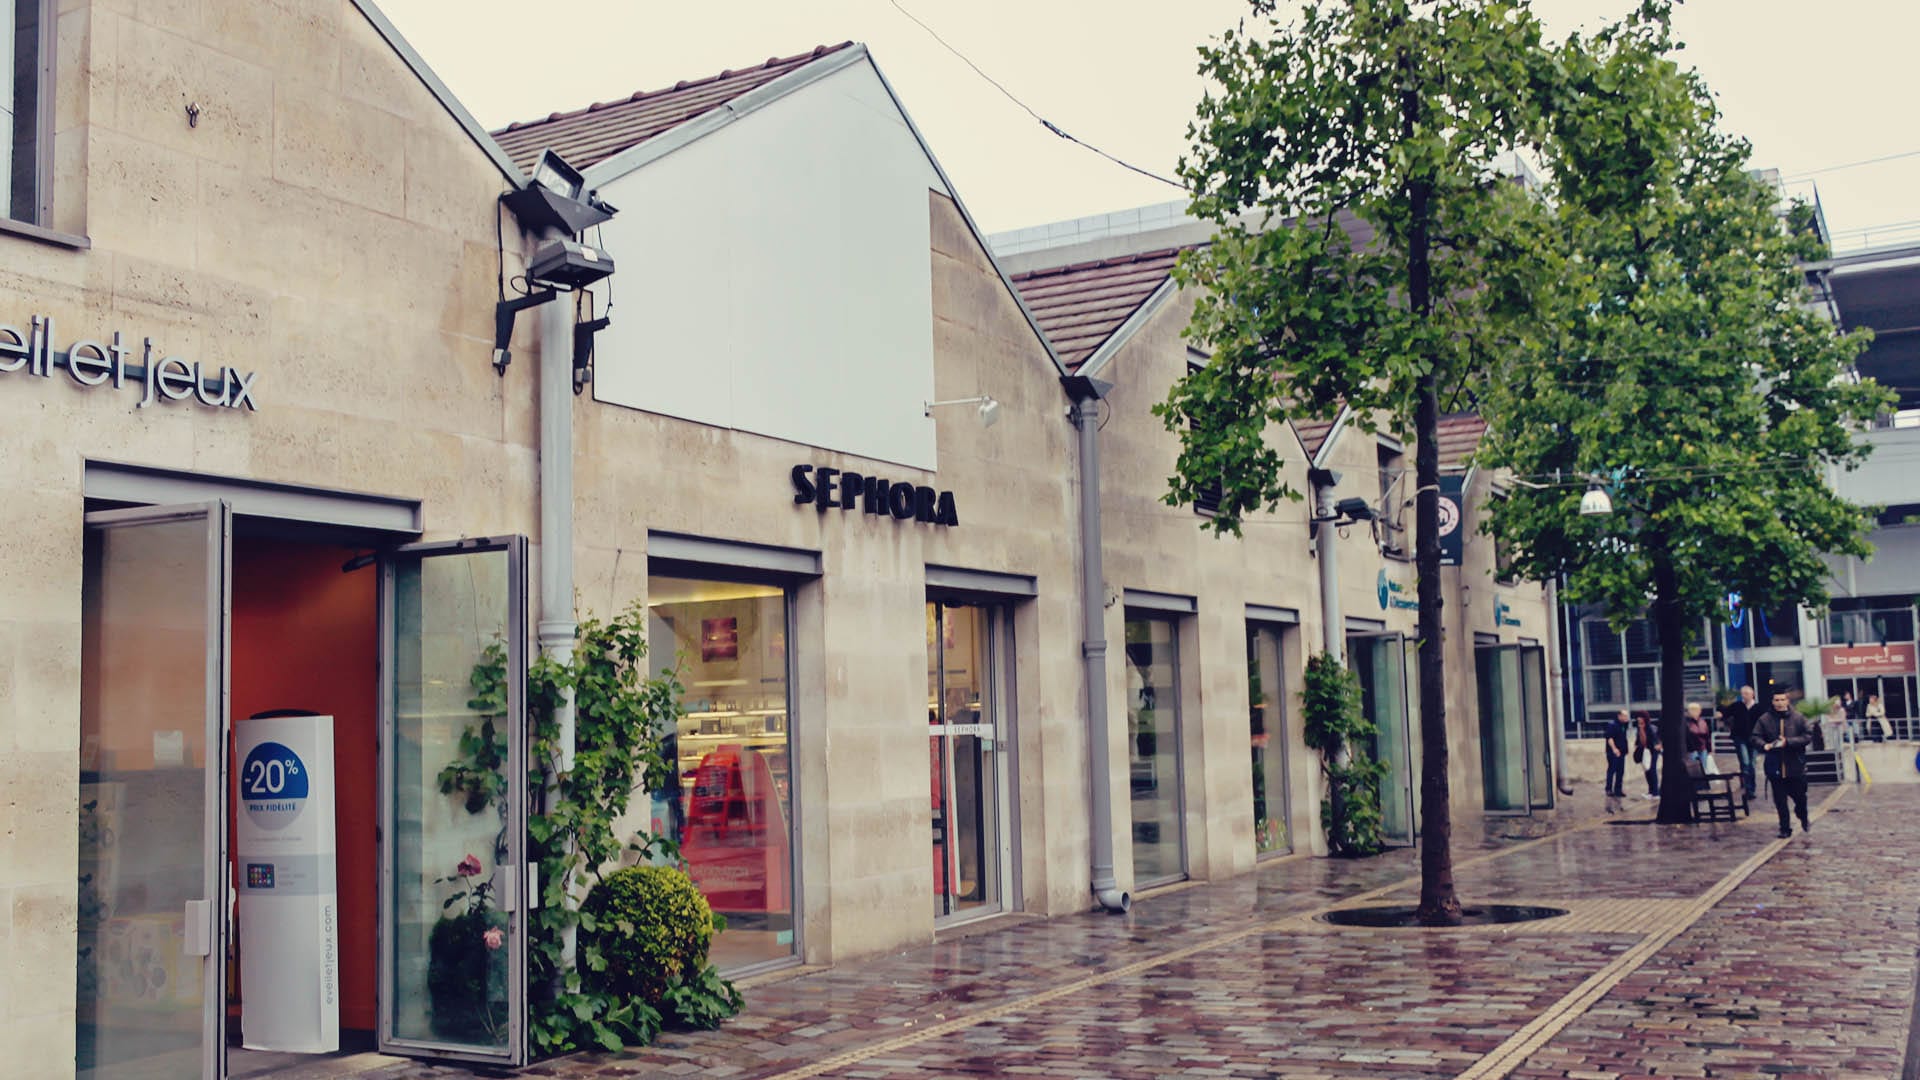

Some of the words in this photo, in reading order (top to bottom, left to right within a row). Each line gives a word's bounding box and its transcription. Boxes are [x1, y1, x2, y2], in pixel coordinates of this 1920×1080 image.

[68, 331, 131, 389] et
[137, 337, 258, 411] jeux
[792, 464, 959, 526] SEPHORA
[245, 759, 299, 793] -20%
